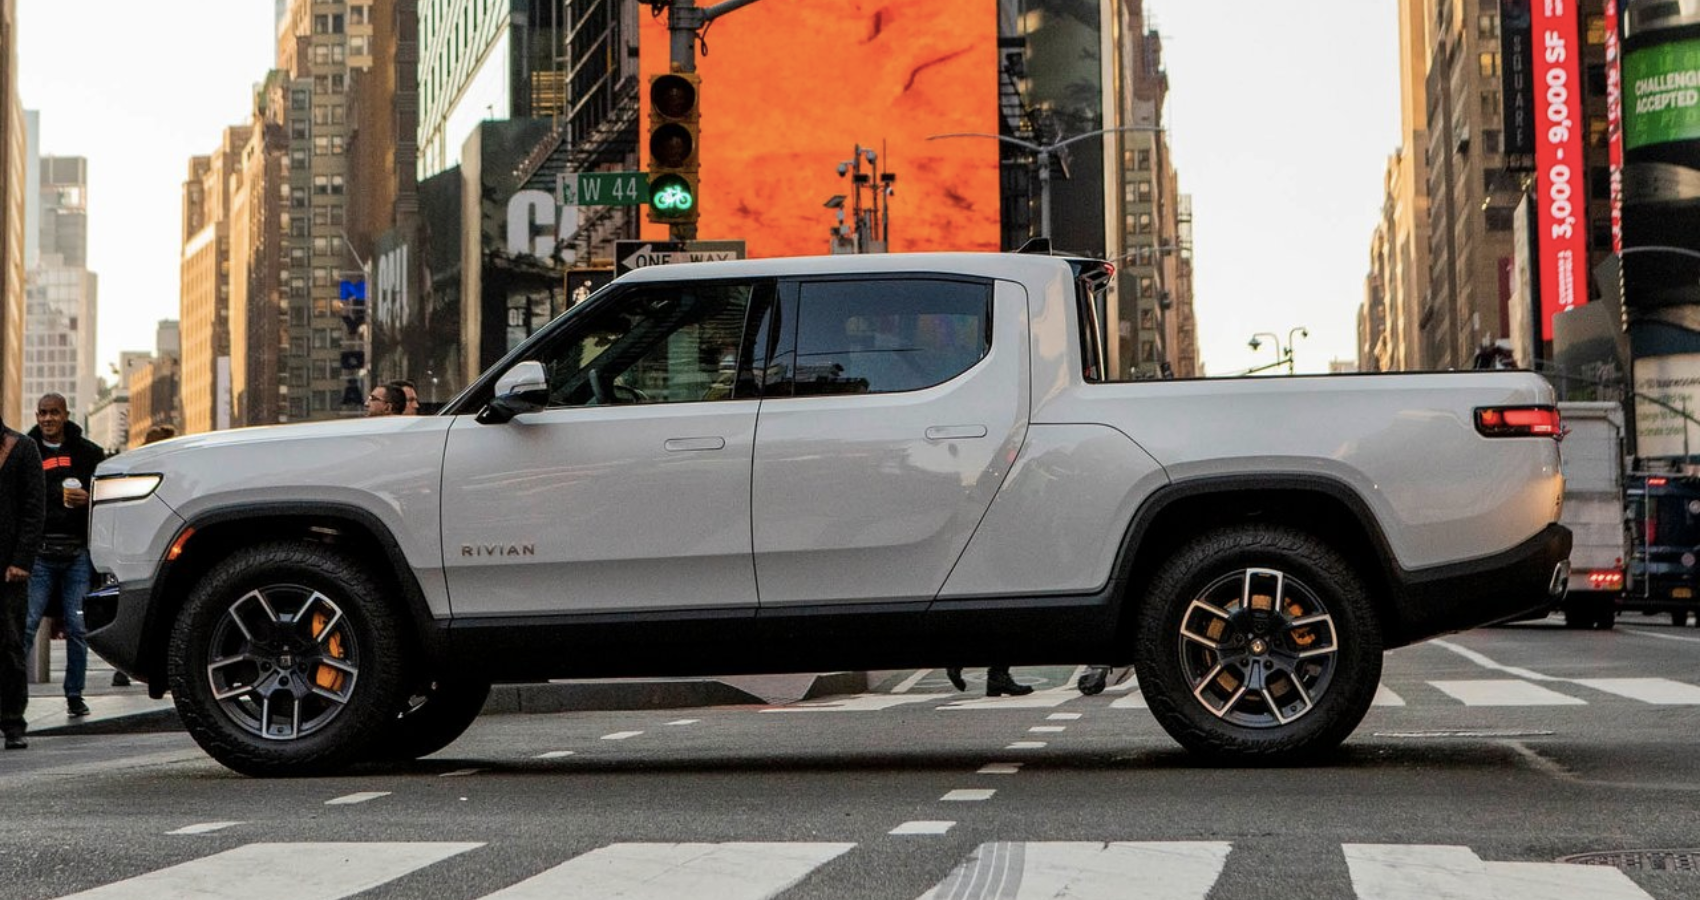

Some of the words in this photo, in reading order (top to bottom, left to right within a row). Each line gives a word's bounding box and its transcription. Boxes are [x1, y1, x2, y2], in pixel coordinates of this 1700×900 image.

[1544, 30, 1566, 63] SF
[1546, 68, 1572, 144] 9,000
[1636, 90, 1698, 115] ACCEPTED
[583, 178, 600, 200] W
[612, 177, 637, 200] 44
[1550, 164, 1577, 240] 3,000
[461, 544, 535, 556] RIVIAN
